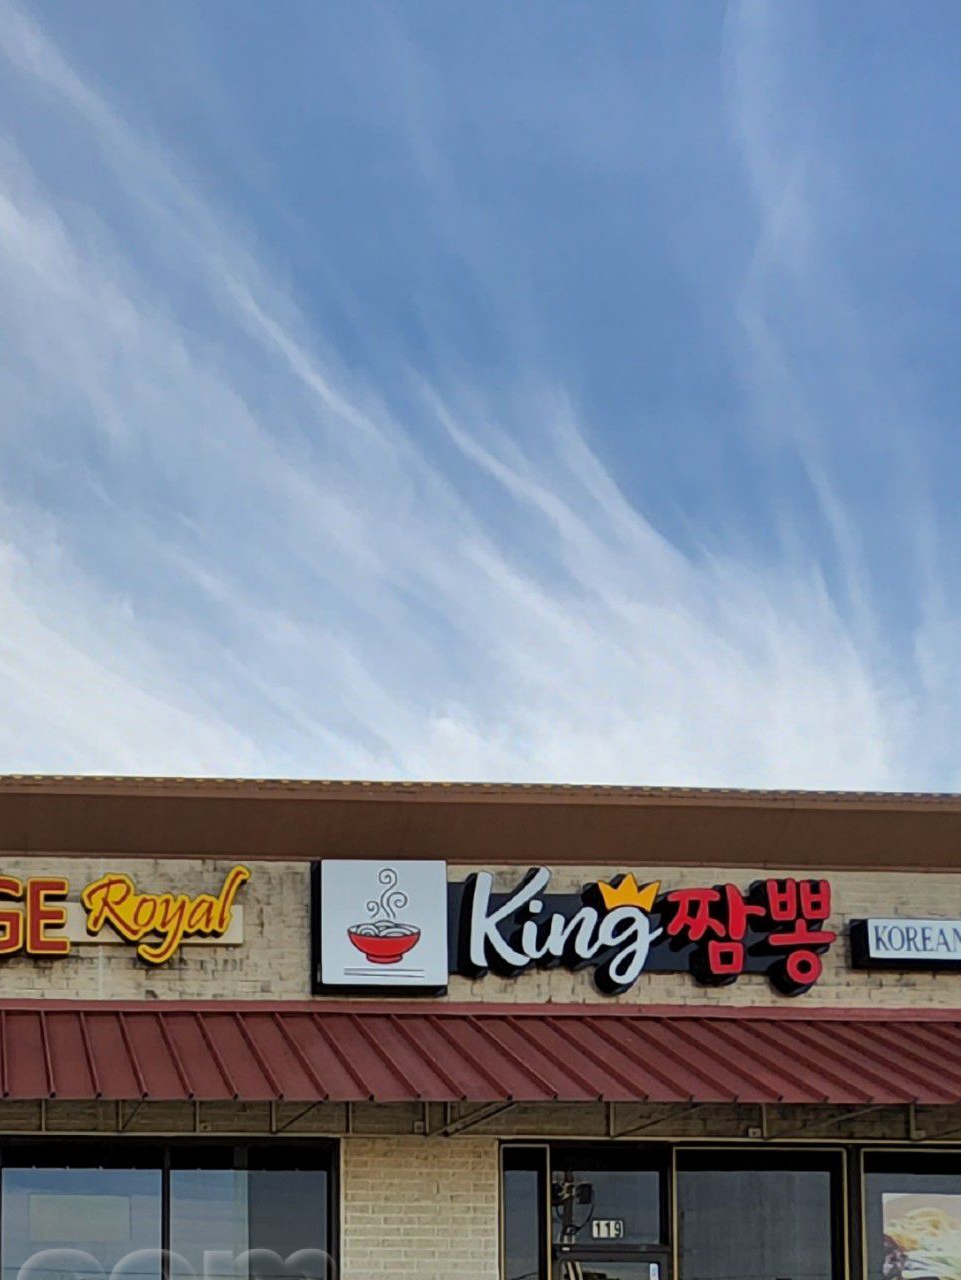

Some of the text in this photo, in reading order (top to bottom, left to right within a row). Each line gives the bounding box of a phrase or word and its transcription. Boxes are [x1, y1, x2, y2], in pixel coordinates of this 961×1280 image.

[82, 865, 251, 964] Royal
[468, 866, 836, 985] King 짬뽕
[596, 1221, 622, 1239] 119
